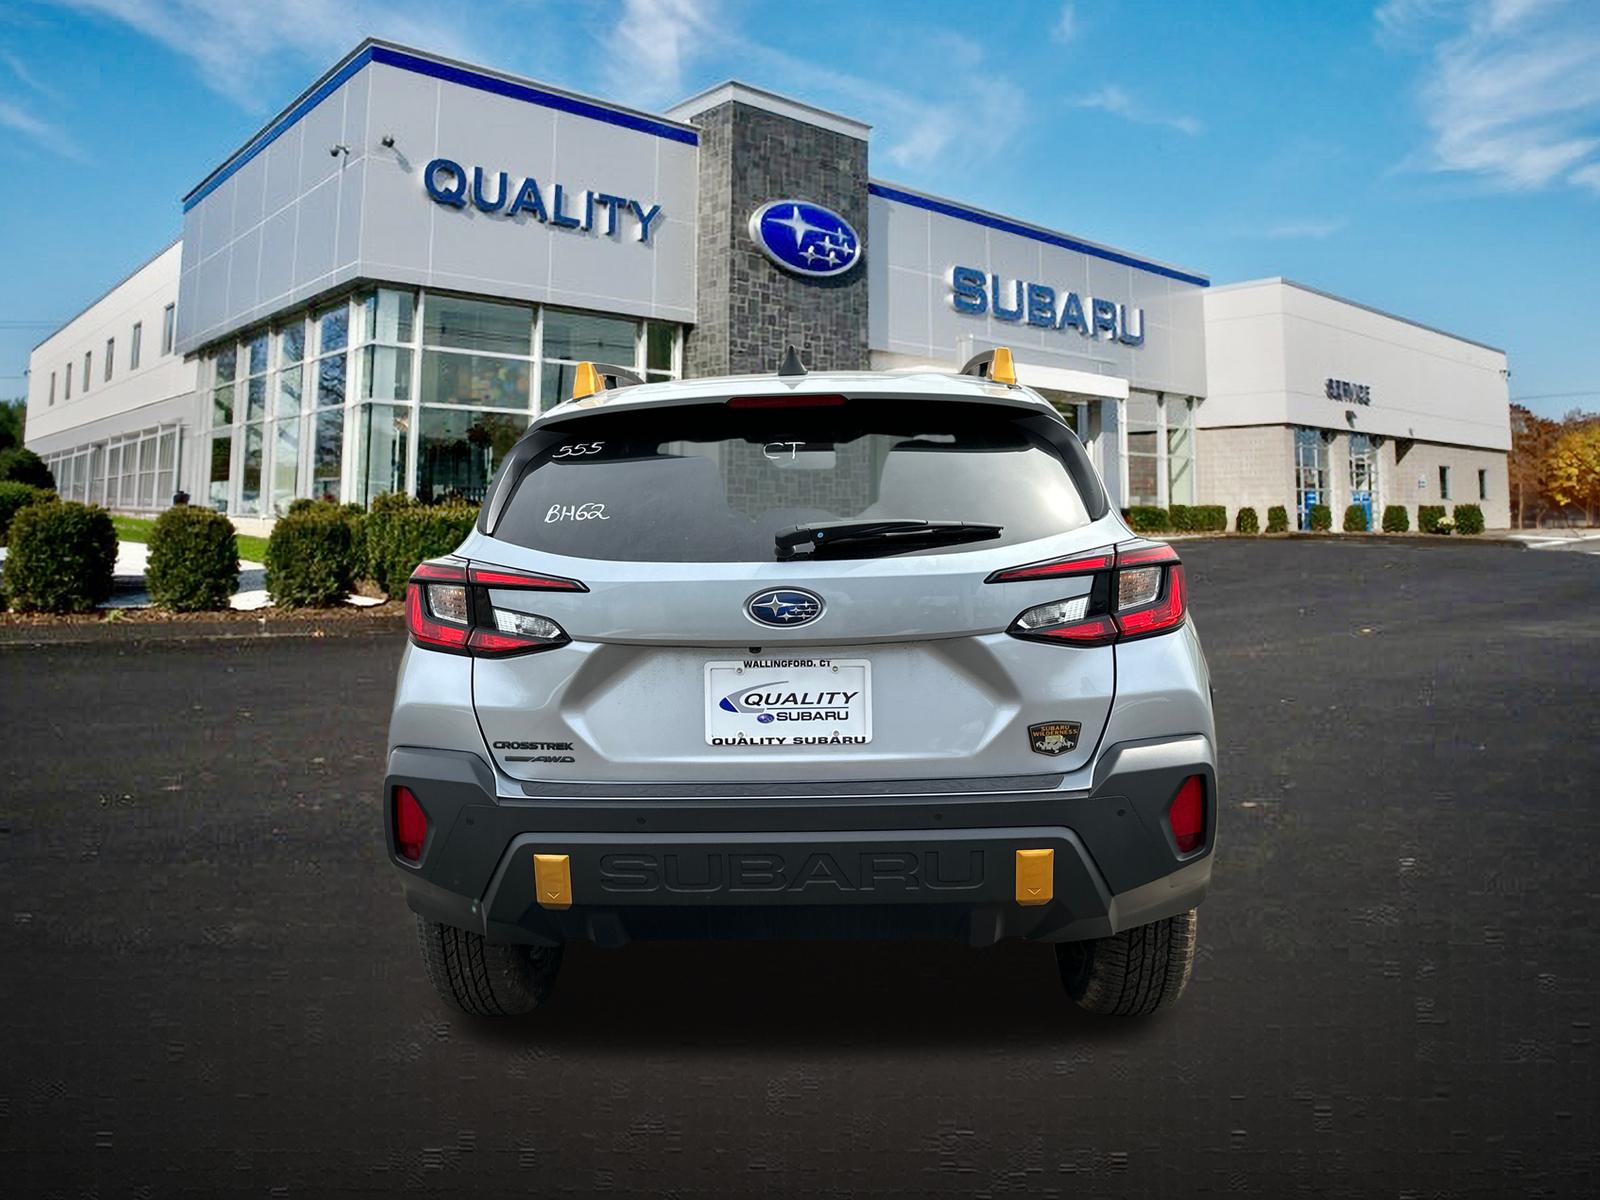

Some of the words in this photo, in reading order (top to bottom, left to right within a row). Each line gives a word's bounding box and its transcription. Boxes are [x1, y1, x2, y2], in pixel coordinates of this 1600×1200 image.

[424, 158, 661, 243] QUALITY
[951, 265, 1145, 346] SUBARU
[552, 441, 605, 458] 555
[763, 441, 806, 460] CT
[544, 502, 610, 523] BH62
[819, 660, 831, 668] CT
[744, 691, 859, 706] QUALITY
[776, 711, 849, 721] SUBARU
[493, 741, 574, 751] CROSSTREK
[712, 737, 787, 746] QUALITY
[793, 736, 866, 745] SUBARU
[600, 849, 985, 893] SUBARU
